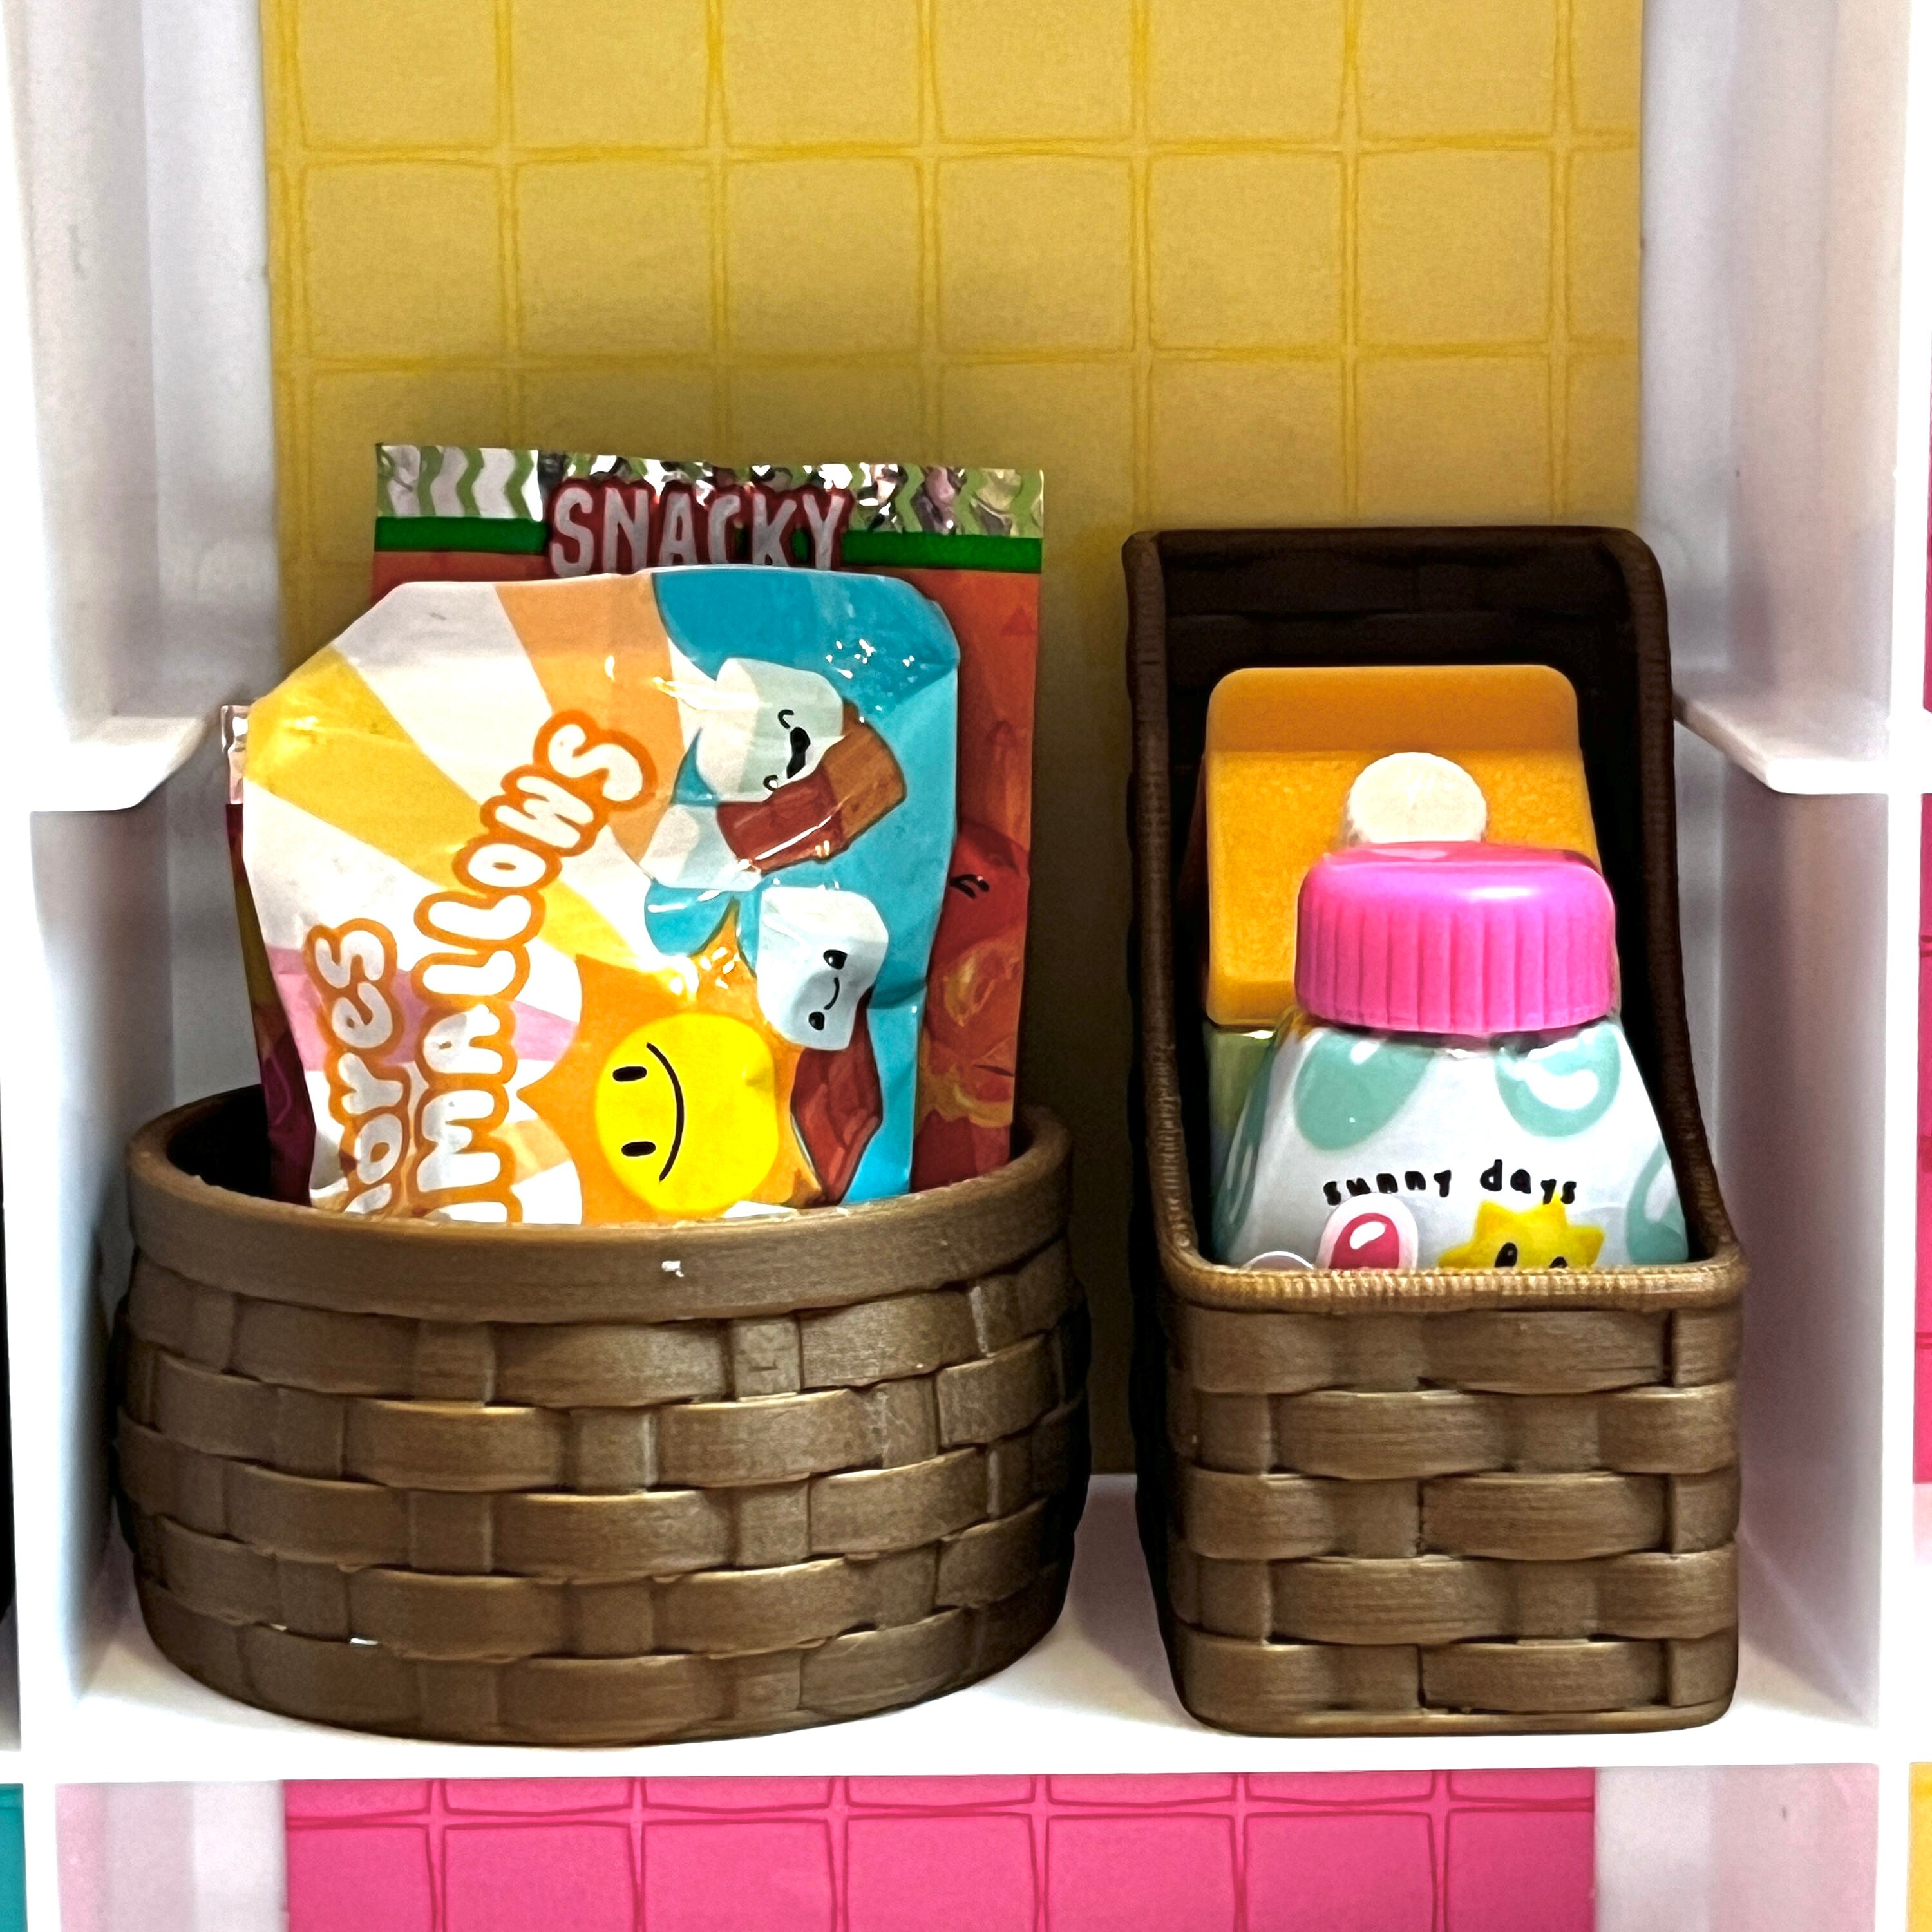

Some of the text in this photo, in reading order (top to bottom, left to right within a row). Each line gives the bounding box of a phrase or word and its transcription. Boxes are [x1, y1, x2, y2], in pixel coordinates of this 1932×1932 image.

[550, 486, 846, 577] SNACKY
[1324, 1159, 1577, 1206] sunny days
